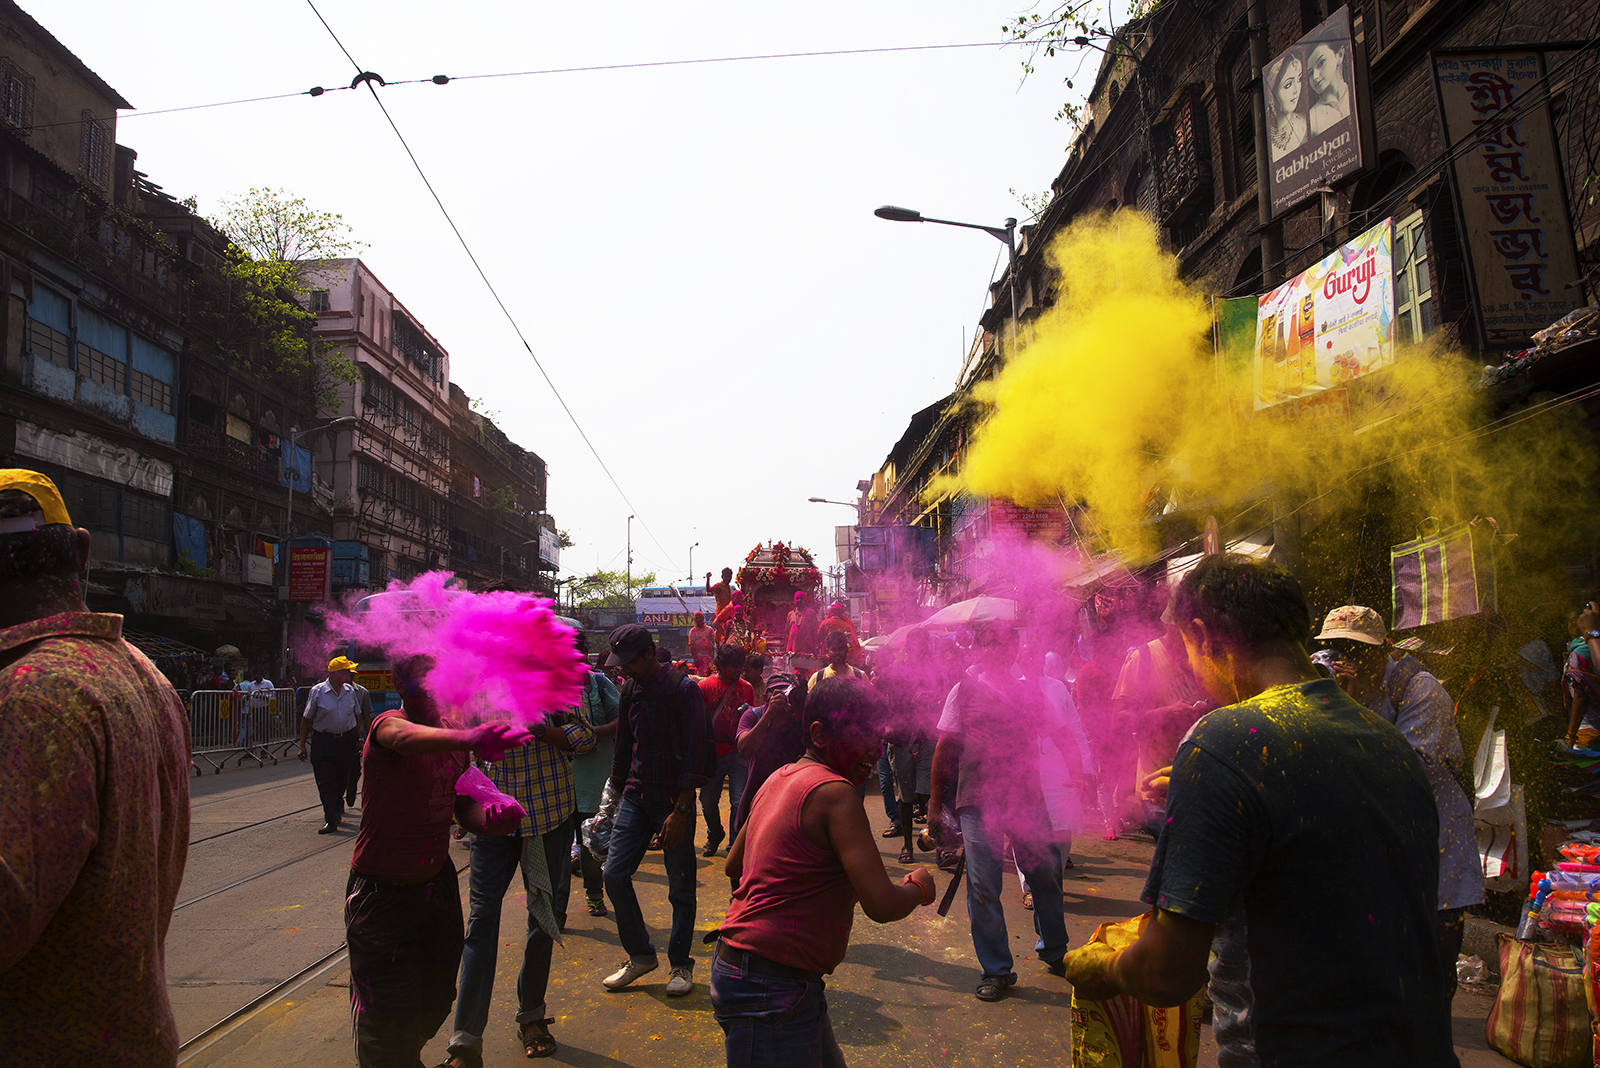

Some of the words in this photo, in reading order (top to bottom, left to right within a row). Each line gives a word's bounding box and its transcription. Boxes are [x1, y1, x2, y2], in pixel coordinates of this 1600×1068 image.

[1275, 131, 1351, 184] Aabhushan
[1310, 174, 1323, 186] Park
[1336, 154, 1358, 170] Market
[1321, 147, 1352, 170] Jewellers
[1287, 193, 1306, 207] Emami
[1331, 172, 1344, 182] City
[1323, 247, 1377, 305] Guruji
[643, 614, 671, 622] ANU
